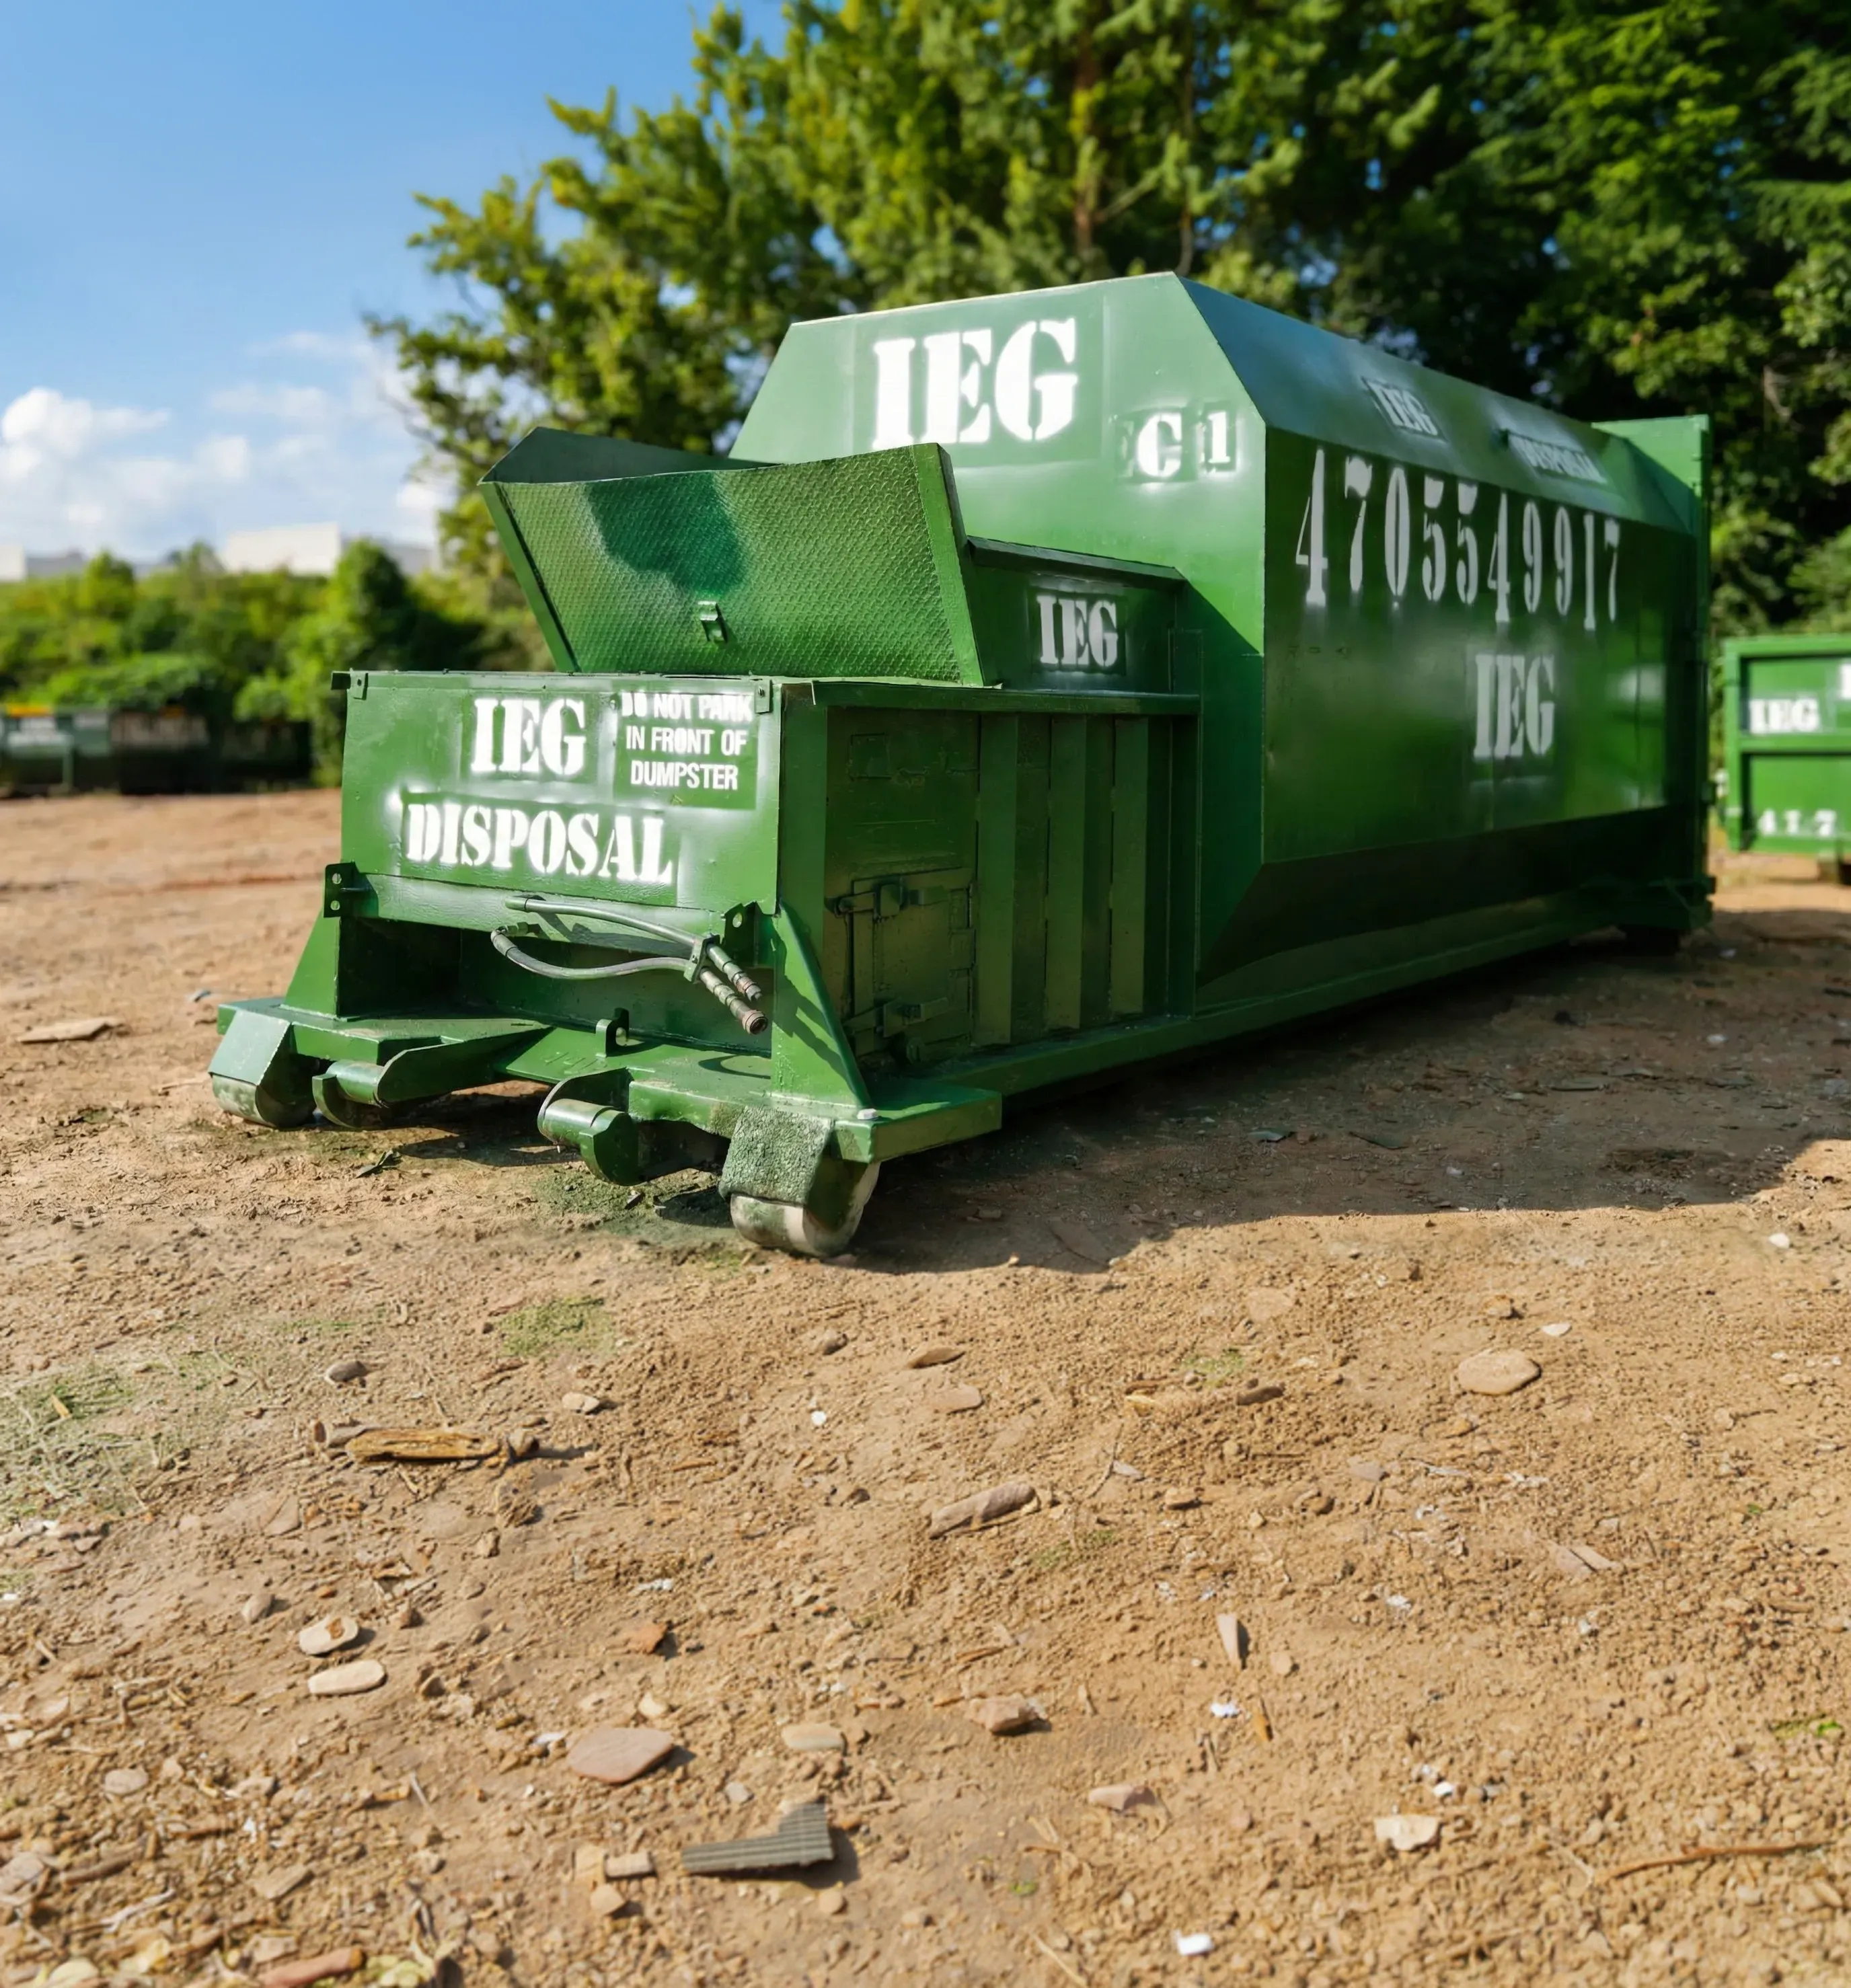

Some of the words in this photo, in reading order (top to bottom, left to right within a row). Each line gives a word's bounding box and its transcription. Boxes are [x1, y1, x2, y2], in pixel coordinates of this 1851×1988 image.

[870, 317, 1078, 451] IEG
[1295, 449, 1620, 631] 4705549917
[1036, 594, 1118, 668] IEG
[471, 697, 587, 777] IEG
[621, 691, 648, 718] DO
[653, 693, 693, 720] NOT
[626, 725, 646, 750] IN
[650, 726, 715, 755] FRONT
[720, 730, 748, 756] OF
[1473, 654, 1556, 760] IEG
[630, 760, 739, 790] DUMPSTER
[406, 803, 673, 885] DISPOSAL
